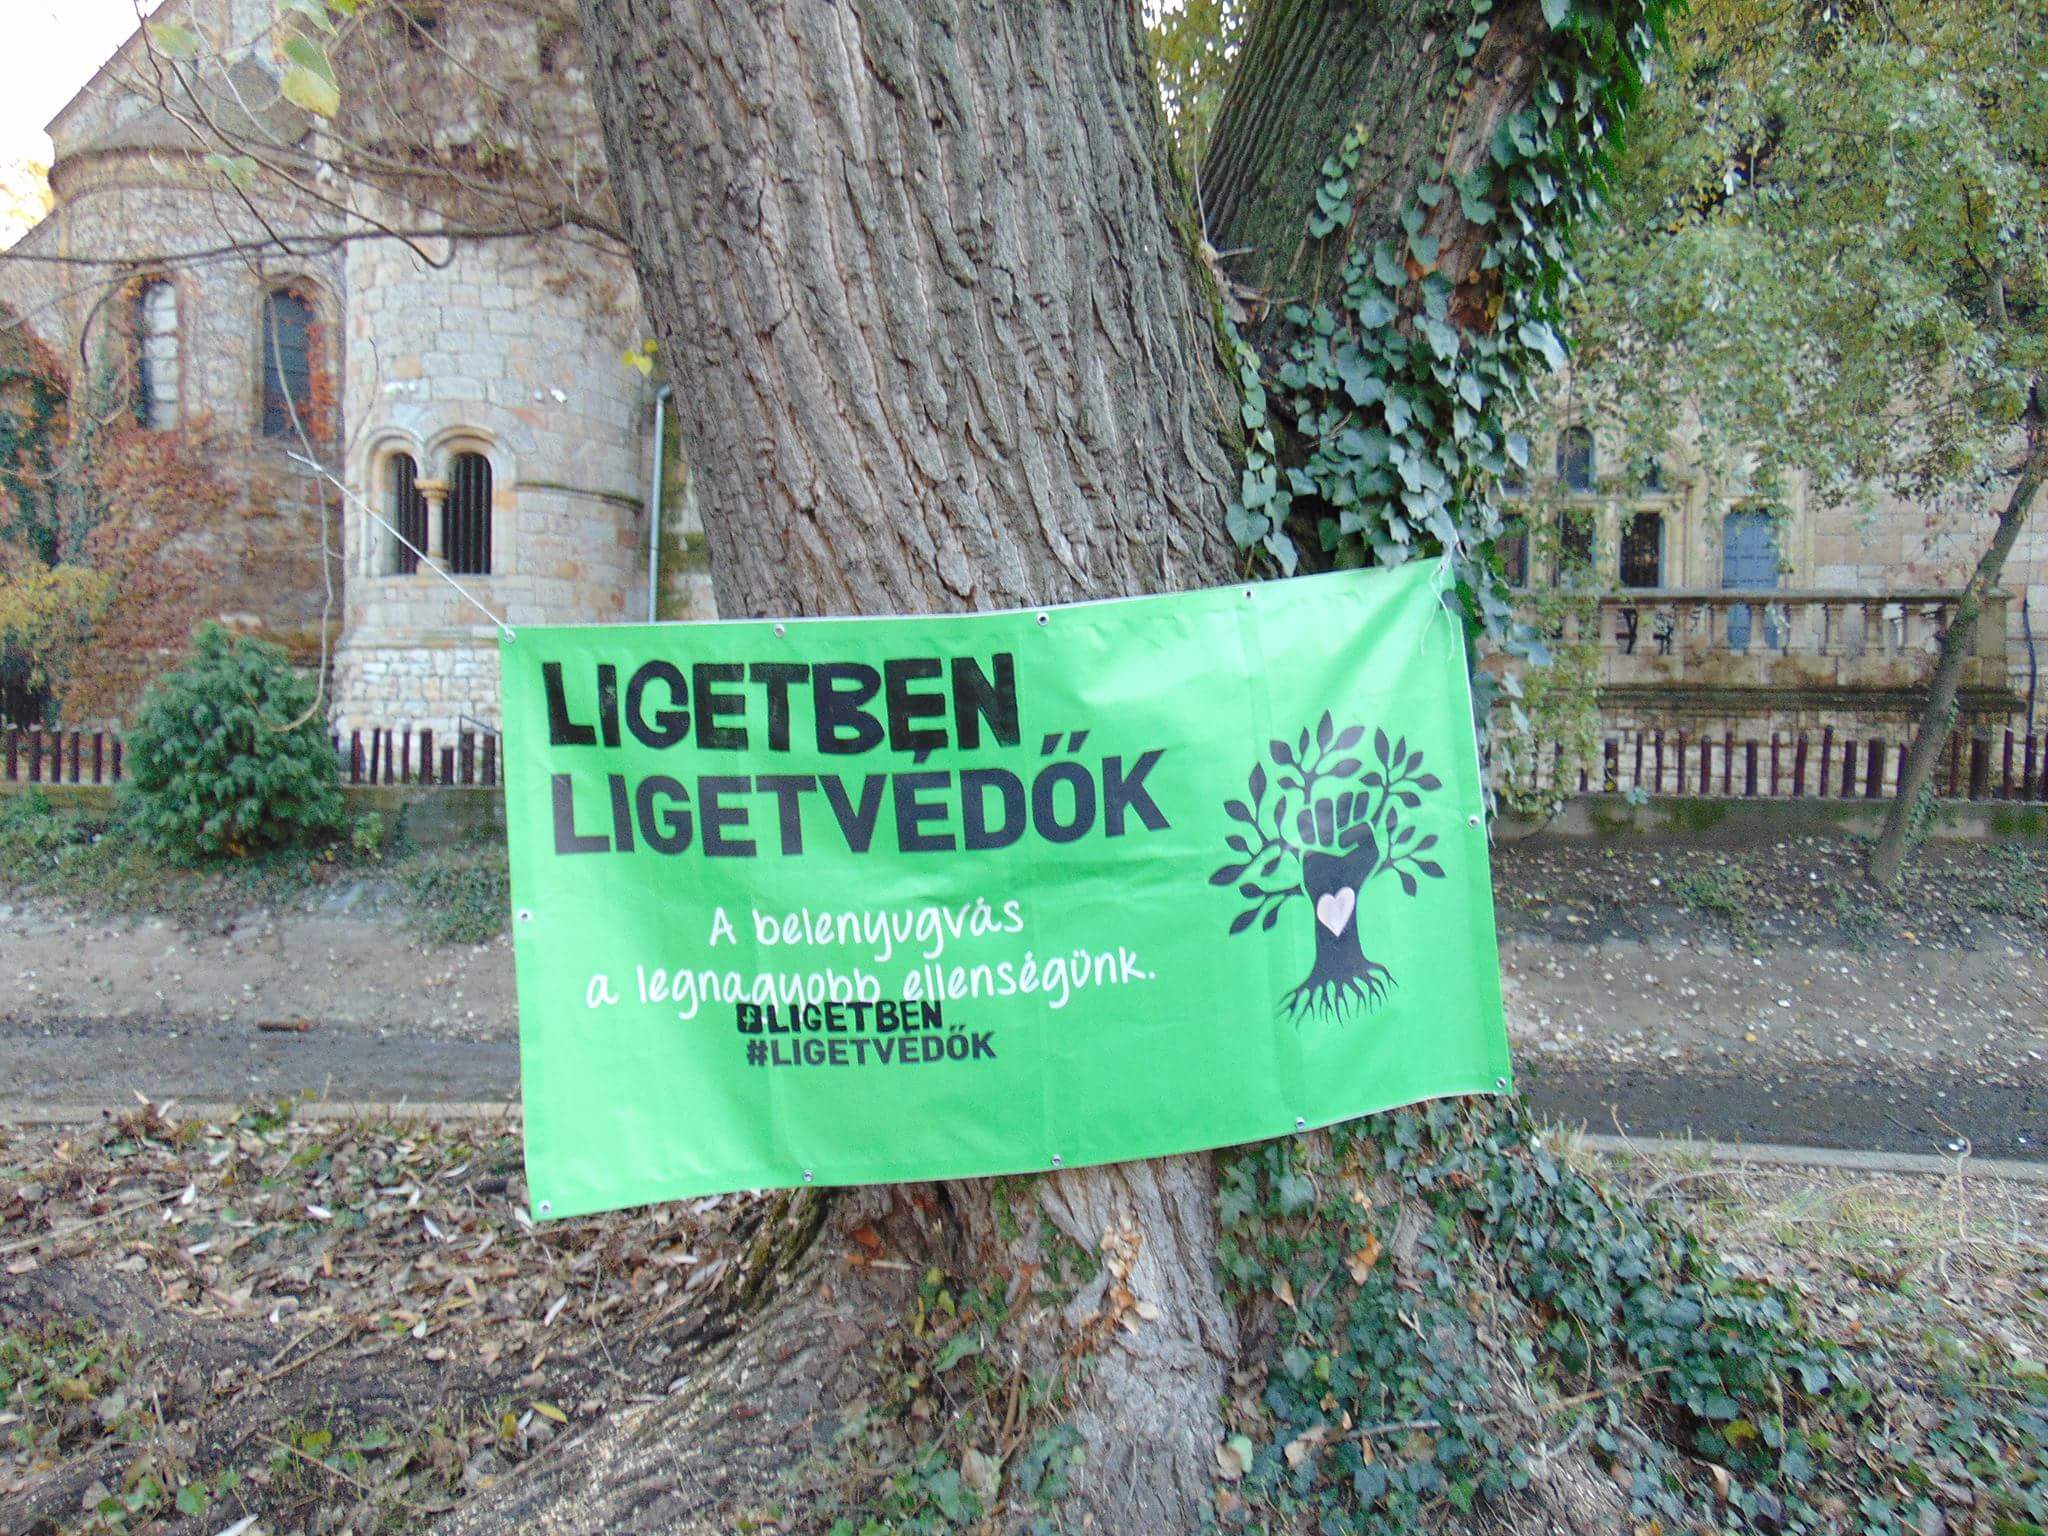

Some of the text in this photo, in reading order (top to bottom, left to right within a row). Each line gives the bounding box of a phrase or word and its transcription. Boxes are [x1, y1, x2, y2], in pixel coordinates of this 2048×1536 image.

[542, 653, 1020, 754] LIGETBEN
[551, 731, 1171, 856] LIGETVÉDŐK
[709, 897, 1023, 962] A belenyugvás
[586, 947, 1155, 1021] a legnagyobb ellenségünk.
